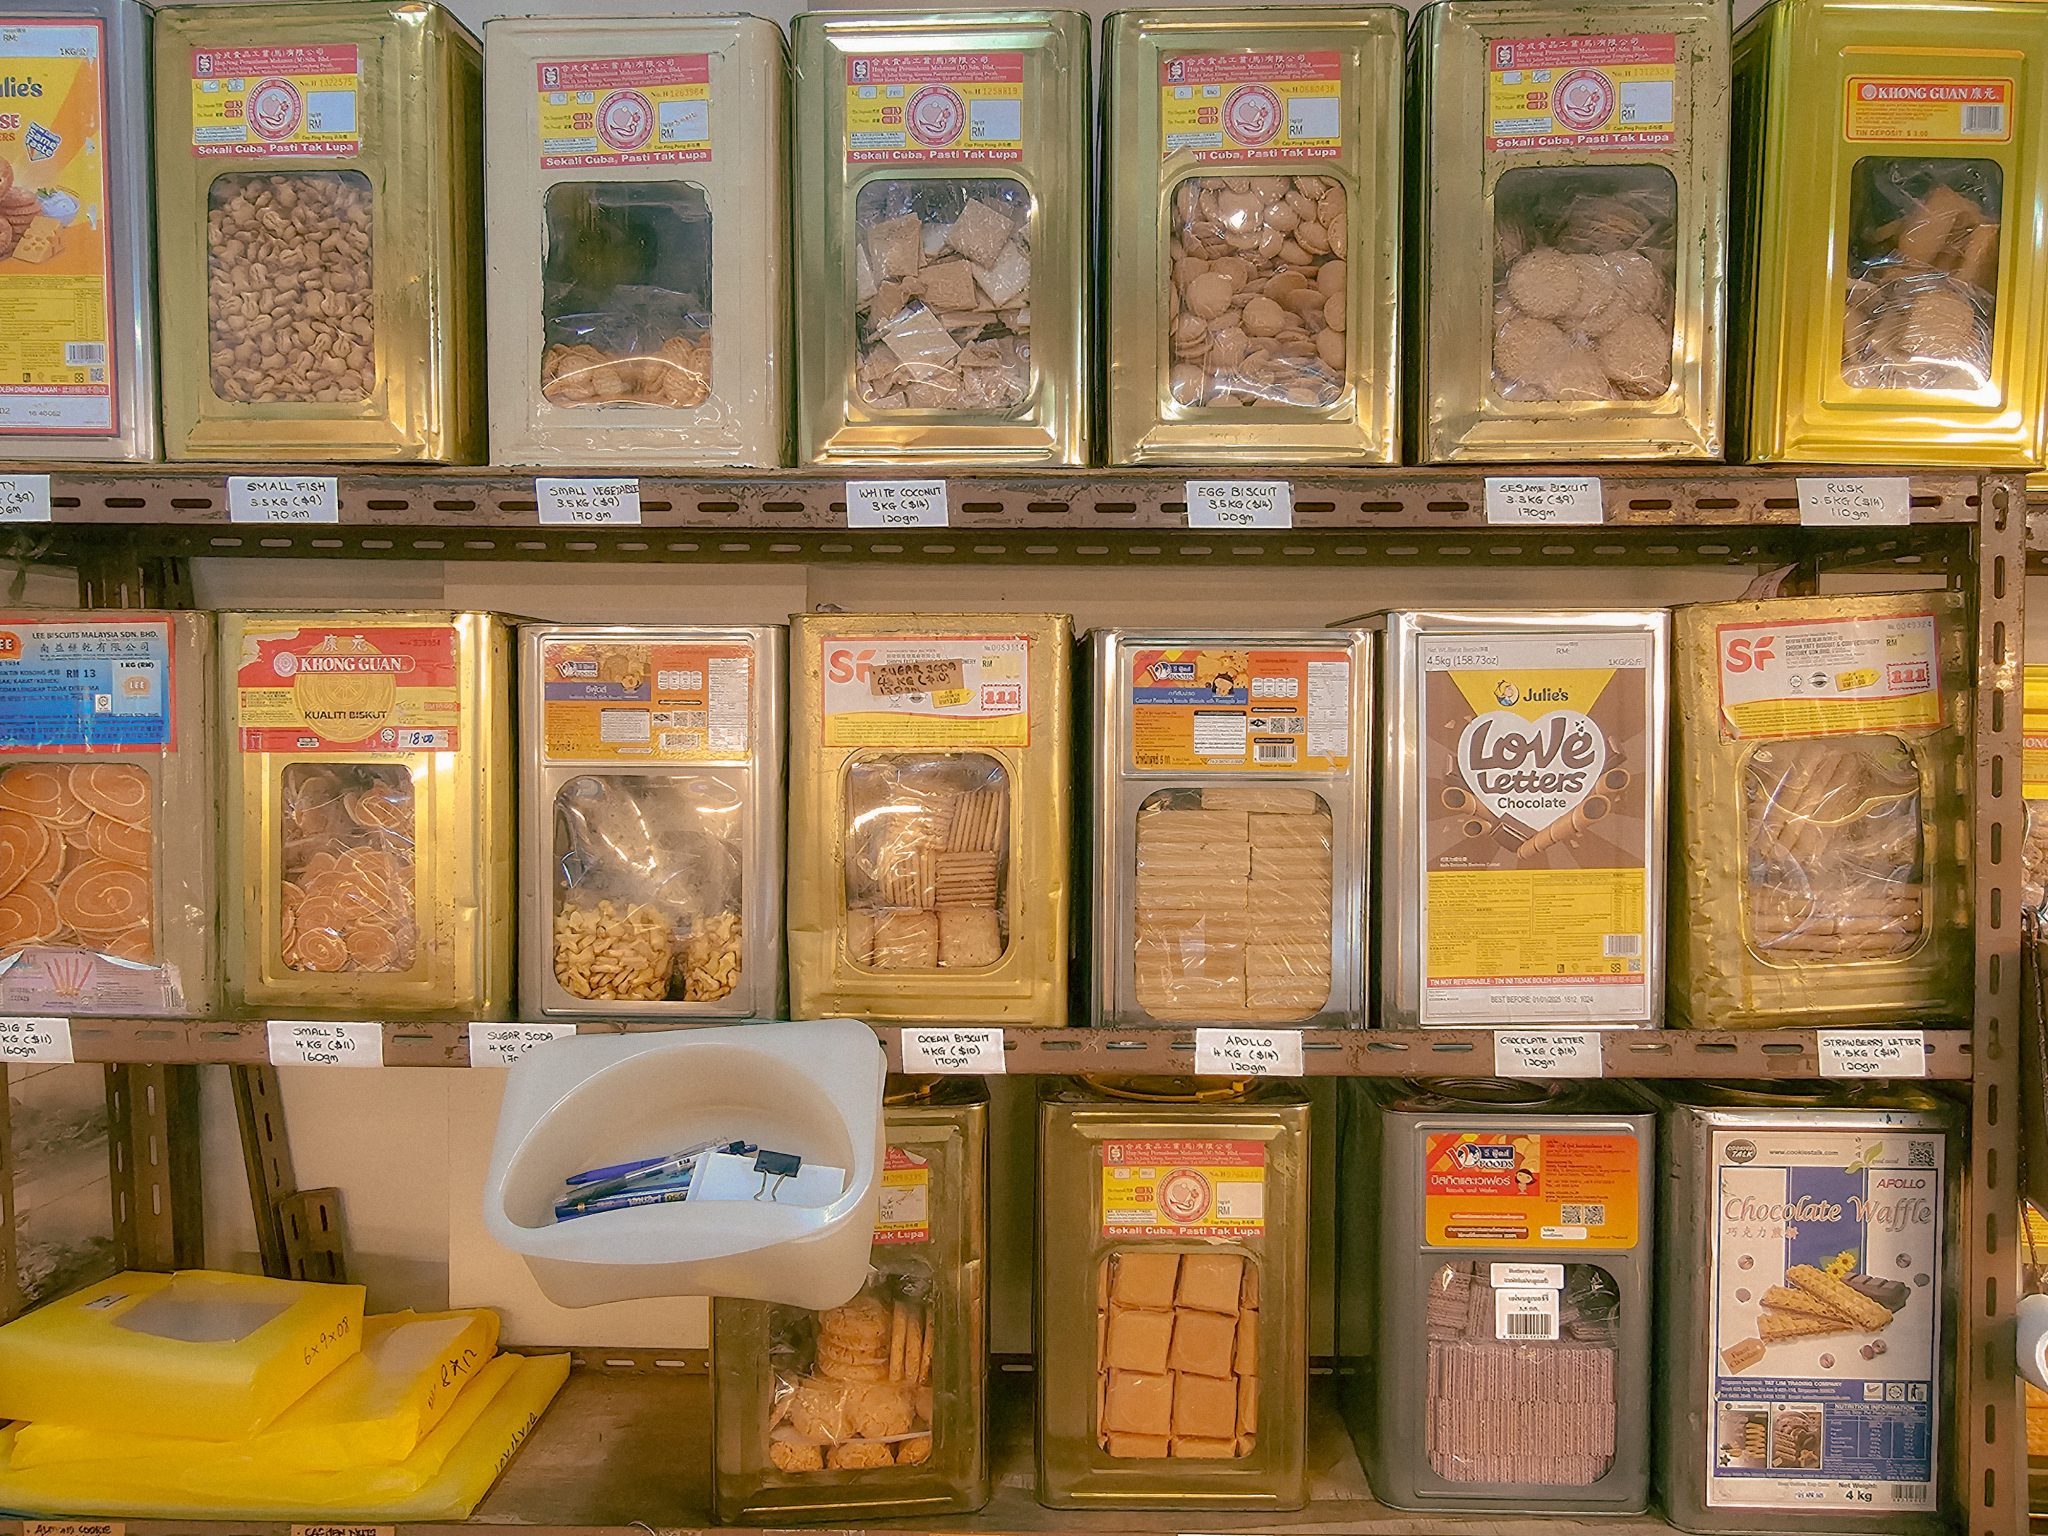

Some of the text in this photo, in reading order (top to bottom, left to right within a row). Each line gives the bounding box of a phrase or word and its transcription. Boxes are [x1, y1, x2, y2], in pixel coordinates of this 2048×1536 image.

[1878, 87, 1967, 99] KHONG GUAN
[28, 128, 57, 149] Same
[1496, 133, 1669, 148] Sekali Cuba, Pasti Tak Lupa
[26, 138, 54, 158] Taste
[198, 142, 354, 154] Sekali Cuba, Pasti Tak Lupa
[546, 151, 707, 167] Sekali Cuba, Pasti Tak Lupa
[853, 150, 1018, 161] Sekali Cuba, Pasti Tak Lupa
[1209, 148, 1336, 160] Cuba, Pasti Tak Lupa
[247, 481, 327, 492] SMALL FISH
[549, 486, 587, 496] SMALL
[1197, 486, 1277, 497] EGG BISCUIT
[1499, 483, 1589, 493] SESAME BISCUIT
[1827, 483, 1864, 494] RUSK
[859, 487, 942, 498] WHITE COCONUT
[46, 631, 81, 639] BISCUITS
[81, 630, 119, 638] MALAYSIA
[321, 634, 368, 652] 康元
[1725, 635, 1775, 673] SF
[300, 657, 402, 672] KHONG GUAN
[1427, 655, 1499, 667] 4.5kg (158.73oz)
[84, 669, 97, 679] 13
[881, 664, 924, 676] SUGAR
[1892, 668, 1926, 683] 111
[129, 681, 145, 689] LEE
[984, 690, 1019, 704] 111
[1523, 688, 1569, 702] Julie's
[304, 711, 388, 719] KUALITI BISKUT
[1497, 797, 1567, 810] Chocolate
[25, 1023, 35, 1032] 5
[292, 1028, 345, 1038] SMALL 5
[23, 1034, 53, 1044] ($11)
[487, 1031, 554, 1041] SUGAR SODA
[917, 1034, 990, 1043] OCEAN BISCUIT
[1226, 1035, 1273, 1046] APOLLO
[1552, 1036, 1585, 1045] LETTER
[327, 1038, 356, 1051] ($11)
[1822, 1038, 1922, 1047] STRAWBERRY LETTER
[950, 1045, 981, 1056] ($10)
[1732, 1150, 1755, 1158] TALK
[1769, 1148, 1839, 1157] www.cookiestalk.com
[1478, 1160, 1515, 1168] FOODS
[1876, 1179, 1927, 1189] APOLLO
[1724, 1195, 1932, 1233] Chocolate Waffle
[897, 1231, 924, 1240] Lupa
[1108, 1226, 1261, 1236] Sekali Cuba, Pasti Tak Lupa
[1845, 1490, 1873, 1502] 4 kg
